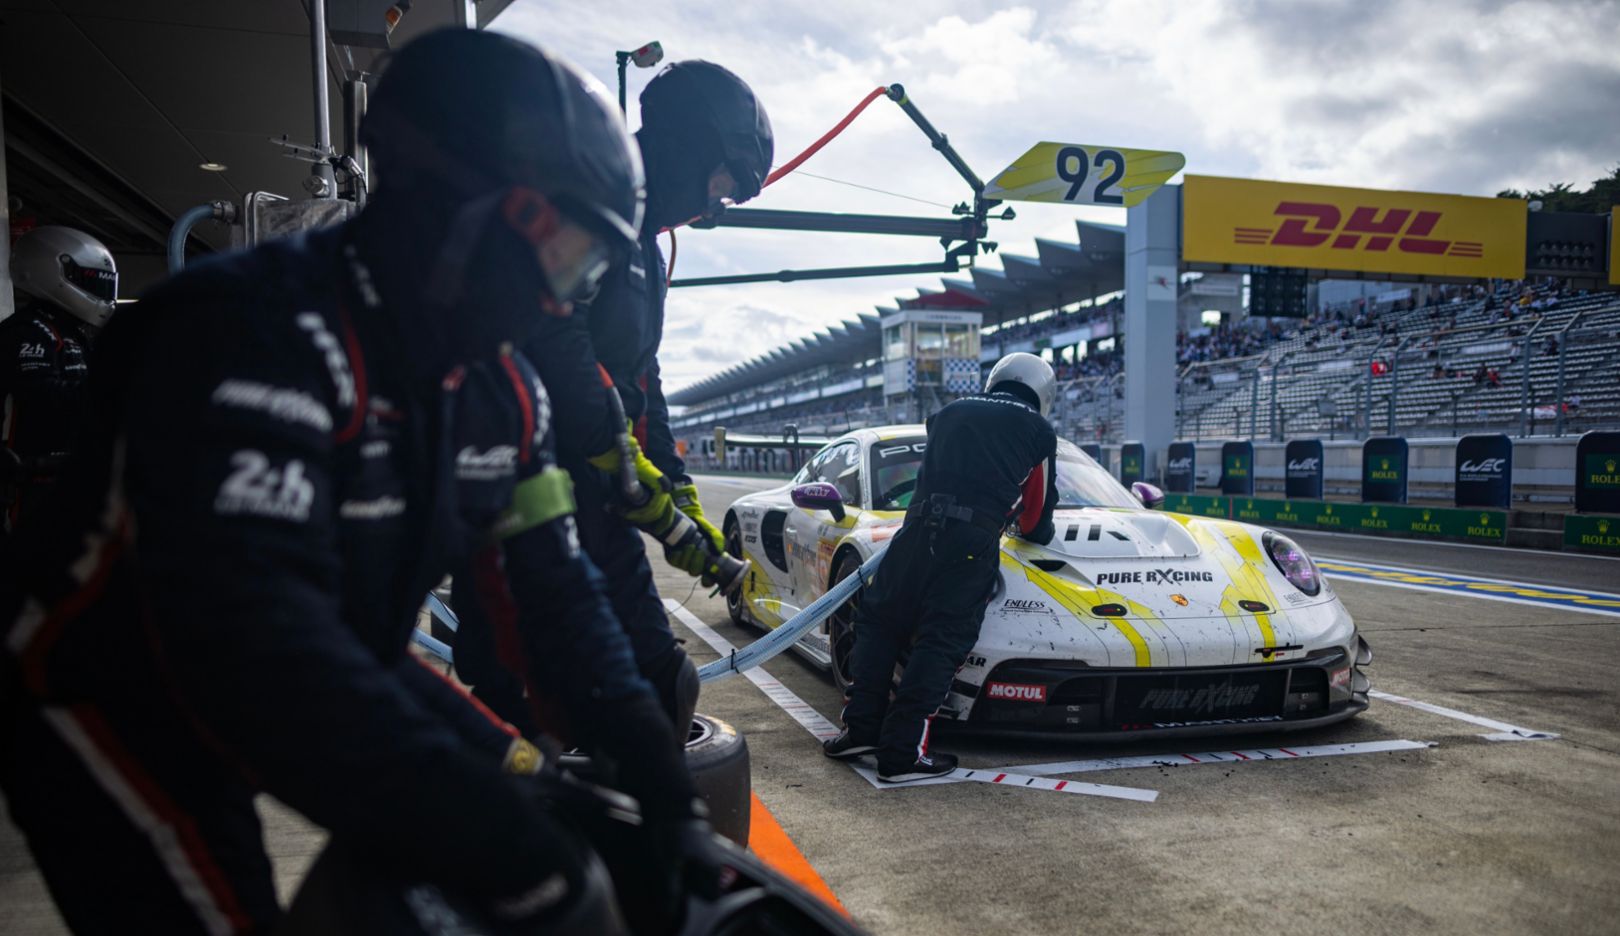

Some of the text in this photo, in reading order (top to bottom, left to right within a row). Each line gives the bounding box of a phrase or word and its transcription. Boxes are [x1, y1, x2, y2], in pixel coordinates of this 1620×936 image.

[1056, 147, 1126, 203] 92
[1270, 201, 1451, 255] DHL
[1459, 458, 1506, 473] WEC
[1372, 471, 1398, 480] ROLEX
[1591, 474, 1620, 485] ROLE
[1276, 513, 1298, 522] ROLEX
[1316, 515, 1341, 525] ROLEX
[1361, 519, 1388, 529] ROLEX
[1411, 522, 1441, 533] ROLEX
[1467, 526, 1501, 537] ROLEX
[1581, 534, 1620, 546] ROLEX
[1097, 572, 1141, 586] PURE
[1003, 599, 1045, 609] ENDLESS
[989, 684, 1043, 700] MOTUL
